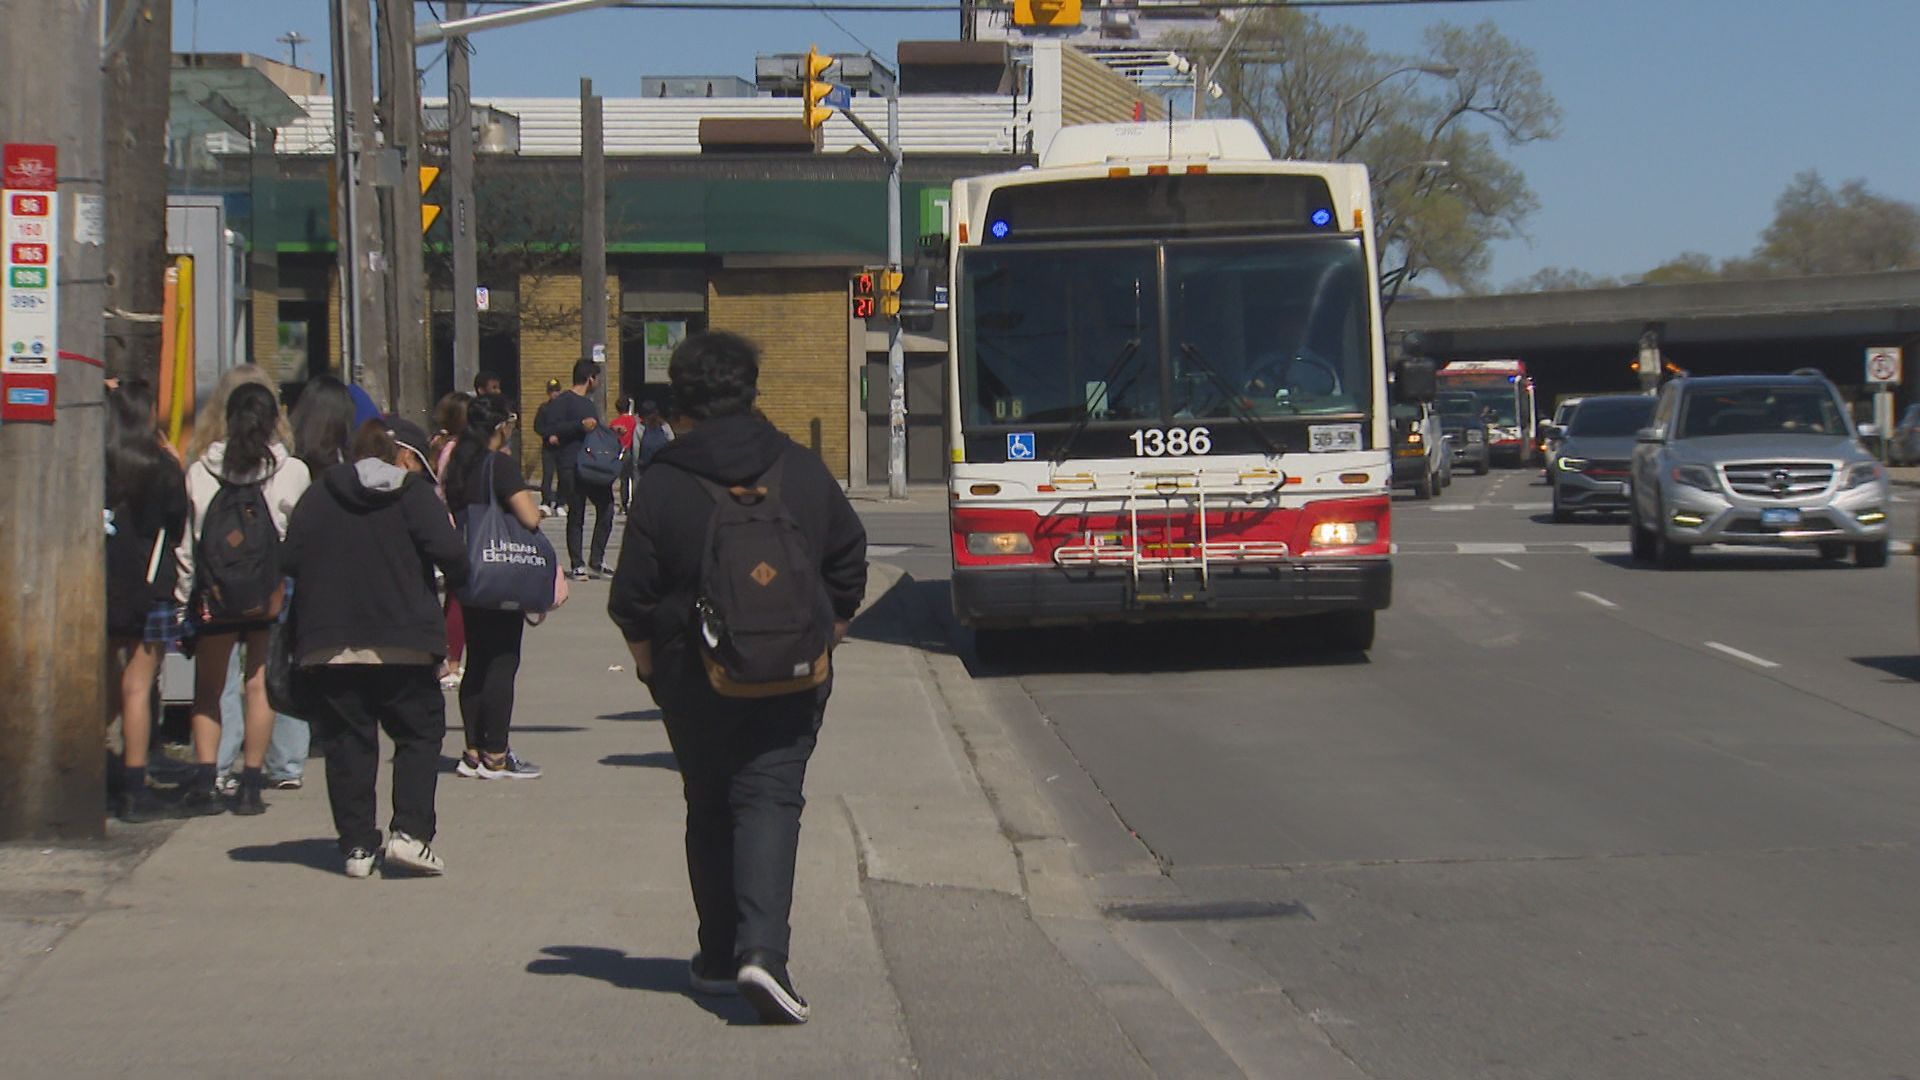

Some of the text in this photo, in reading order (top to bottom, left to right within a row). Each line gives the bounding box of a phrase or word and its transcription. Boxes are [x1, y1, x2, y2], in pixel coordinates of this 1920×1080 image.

[20, 198, 41, 213] 96
[17, 247, 43, 261] 165
[15, 271, 42, 285] 996
[857, 299, 872, 316] 21
[1129, 427, 1211, 457] 1386
[482, 549, 547, 568] BEHAVIOR
